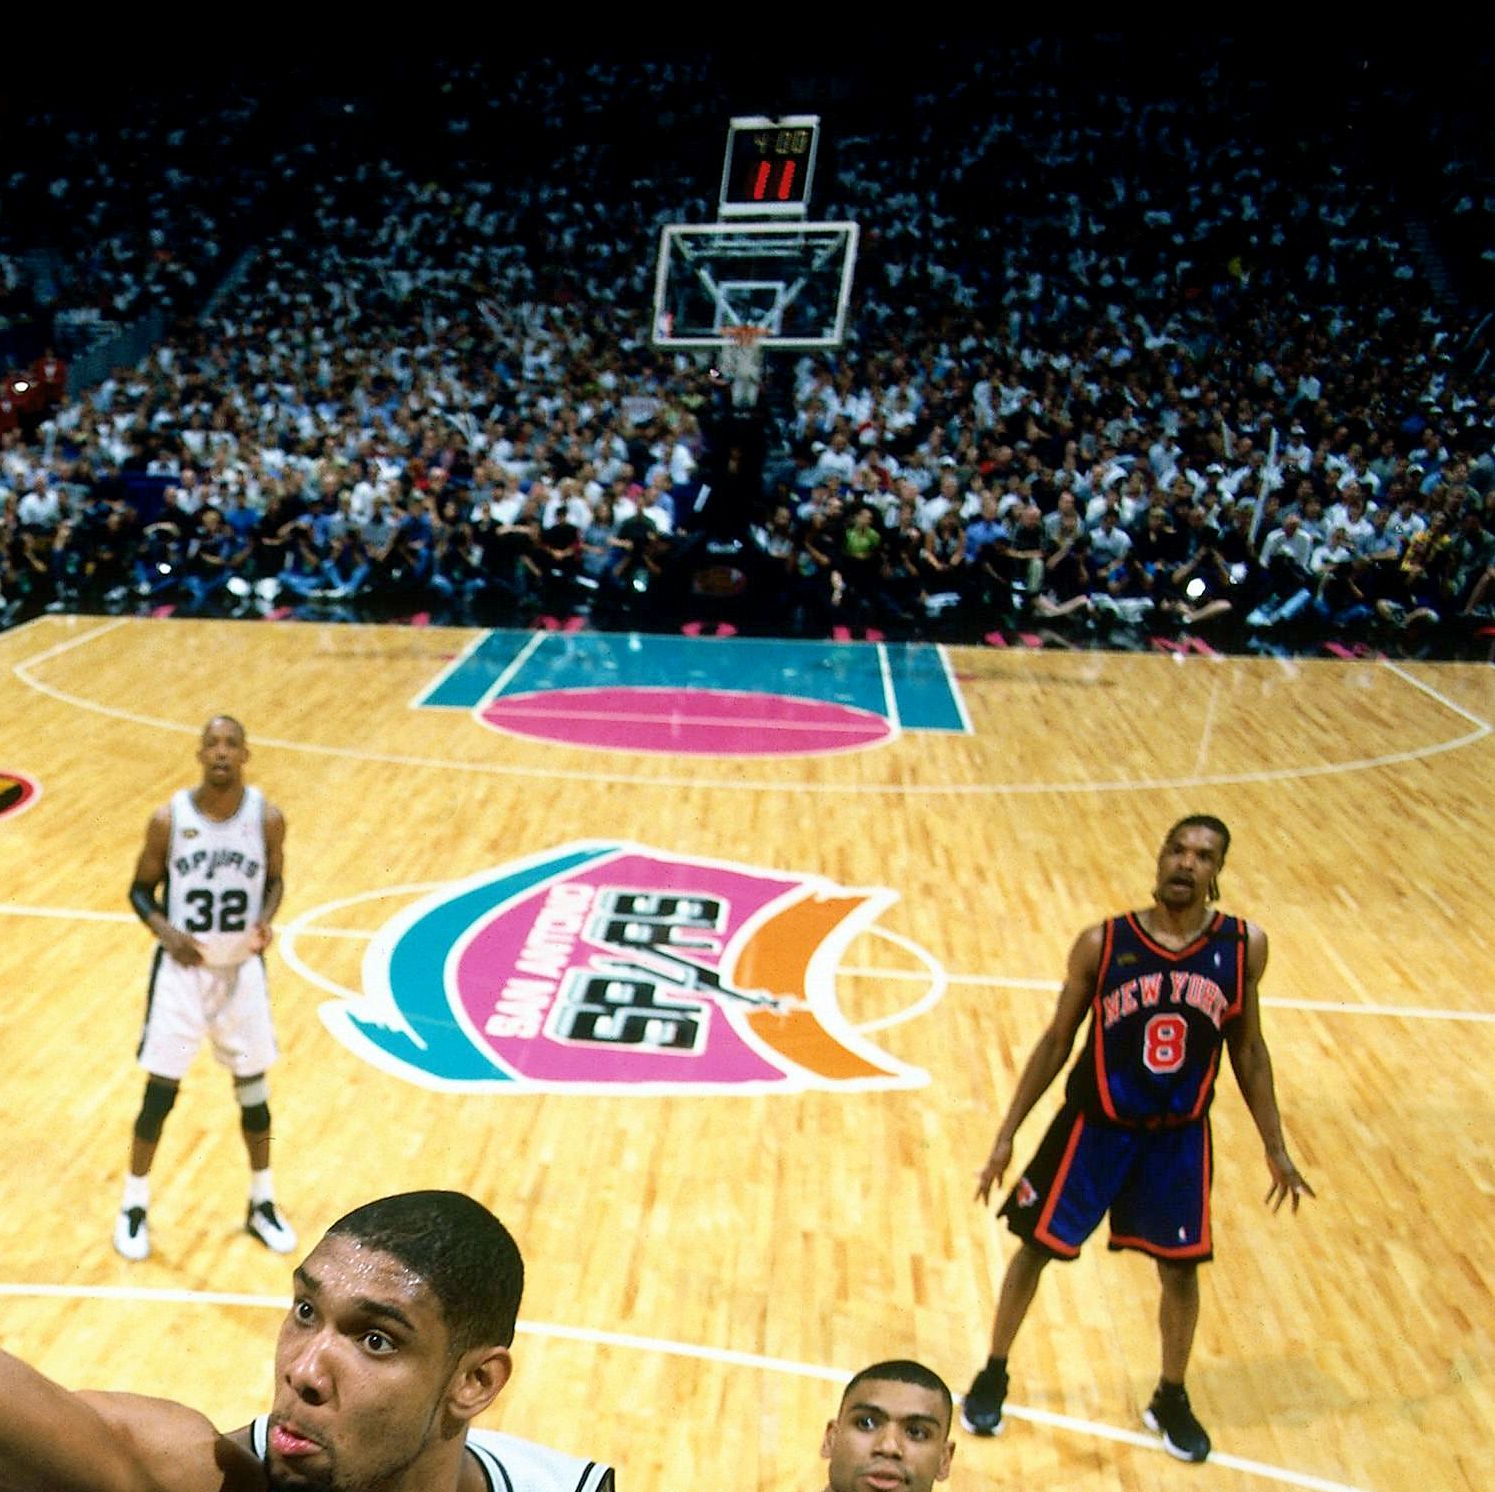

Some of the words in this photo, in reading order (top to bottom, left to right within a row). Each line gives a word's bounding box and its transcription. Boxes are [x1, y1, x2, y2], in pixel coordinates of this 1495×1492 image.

[754, 161, 795, 199] 11
[175, 849, 259, 880] SPURS
[185, 889, 248, 932] 32
[544, 884, 744, 1057] SPURS
[485, 978, 556, 1040] SAN
[1104, 972, 1162, 1029] NEW
[1143, 1013, 1188, 1074] 8
